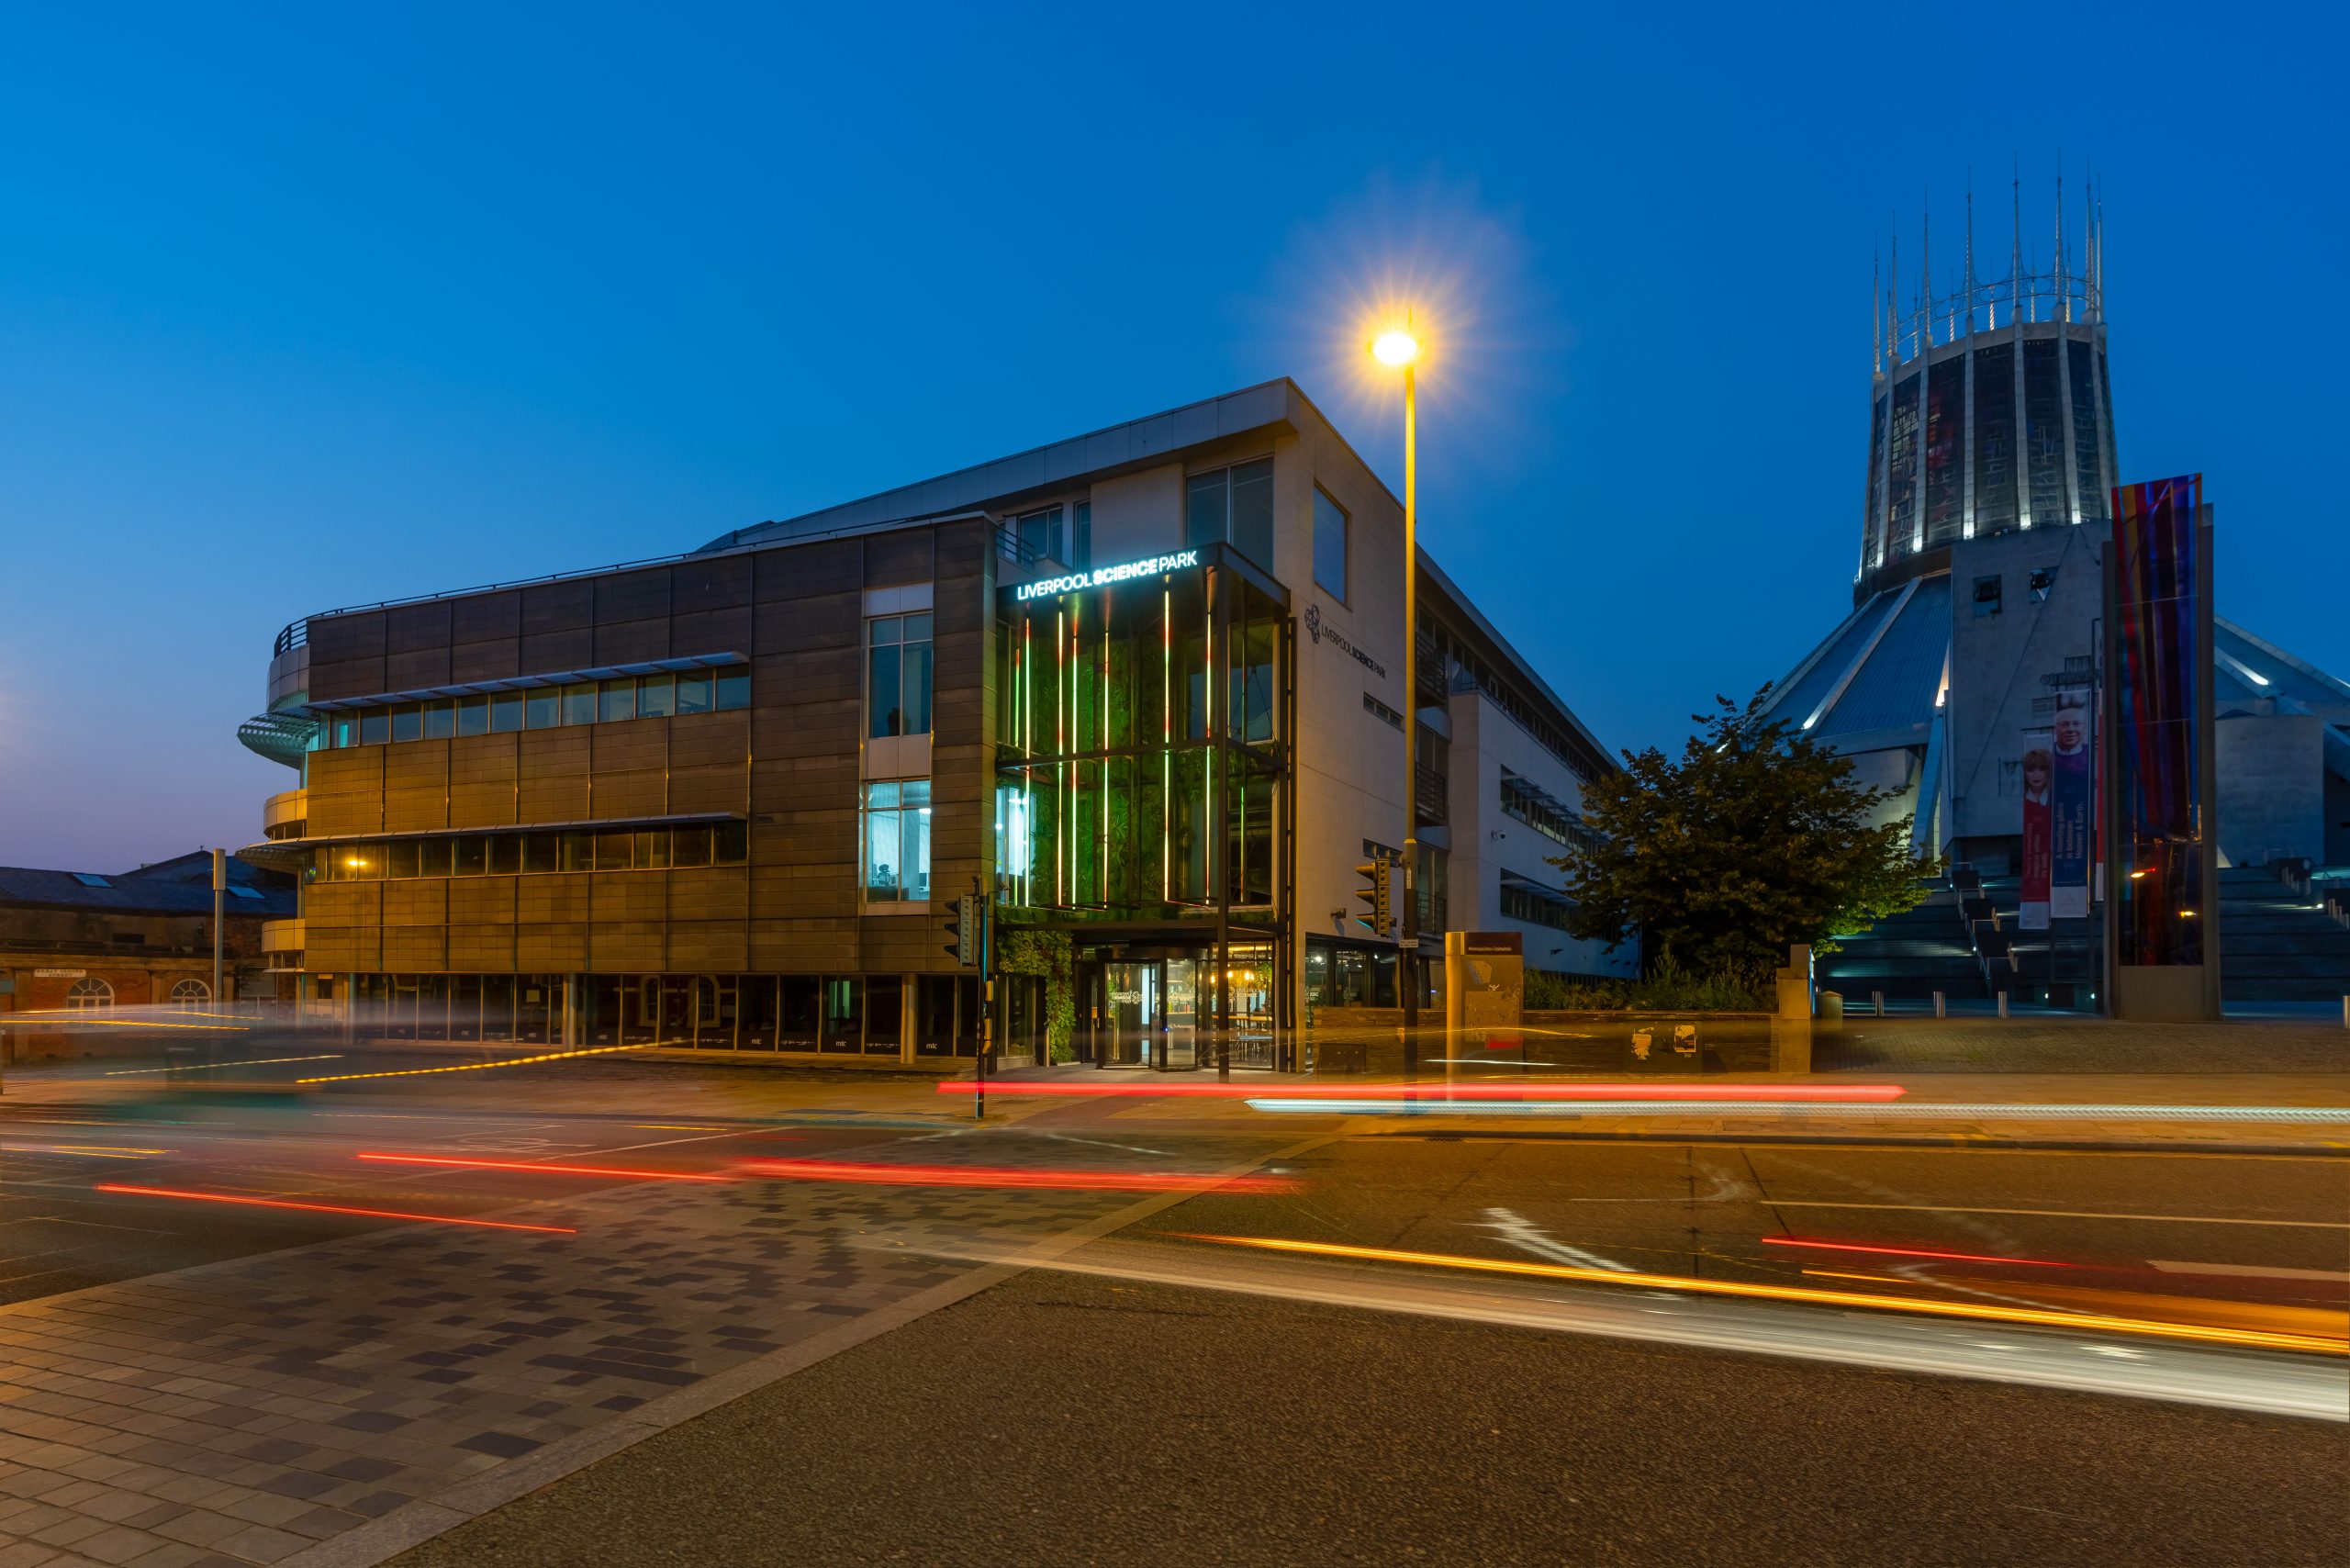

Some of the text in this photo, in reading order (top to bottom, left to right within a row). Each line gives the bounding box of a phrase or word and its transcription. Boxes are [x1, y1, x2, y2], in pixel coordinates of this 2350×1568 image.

[1017, 550, 1198, 601] LIVERPOOL SCIENCE PARK
[1322, 623, 1386, 679] LIVERPOOL SCIENCE PARK
[2056, 823, 2065, 853] meeting
[2065, 819, 2074, 860] in between
[2075, 832, 2083, 859] Heaven
